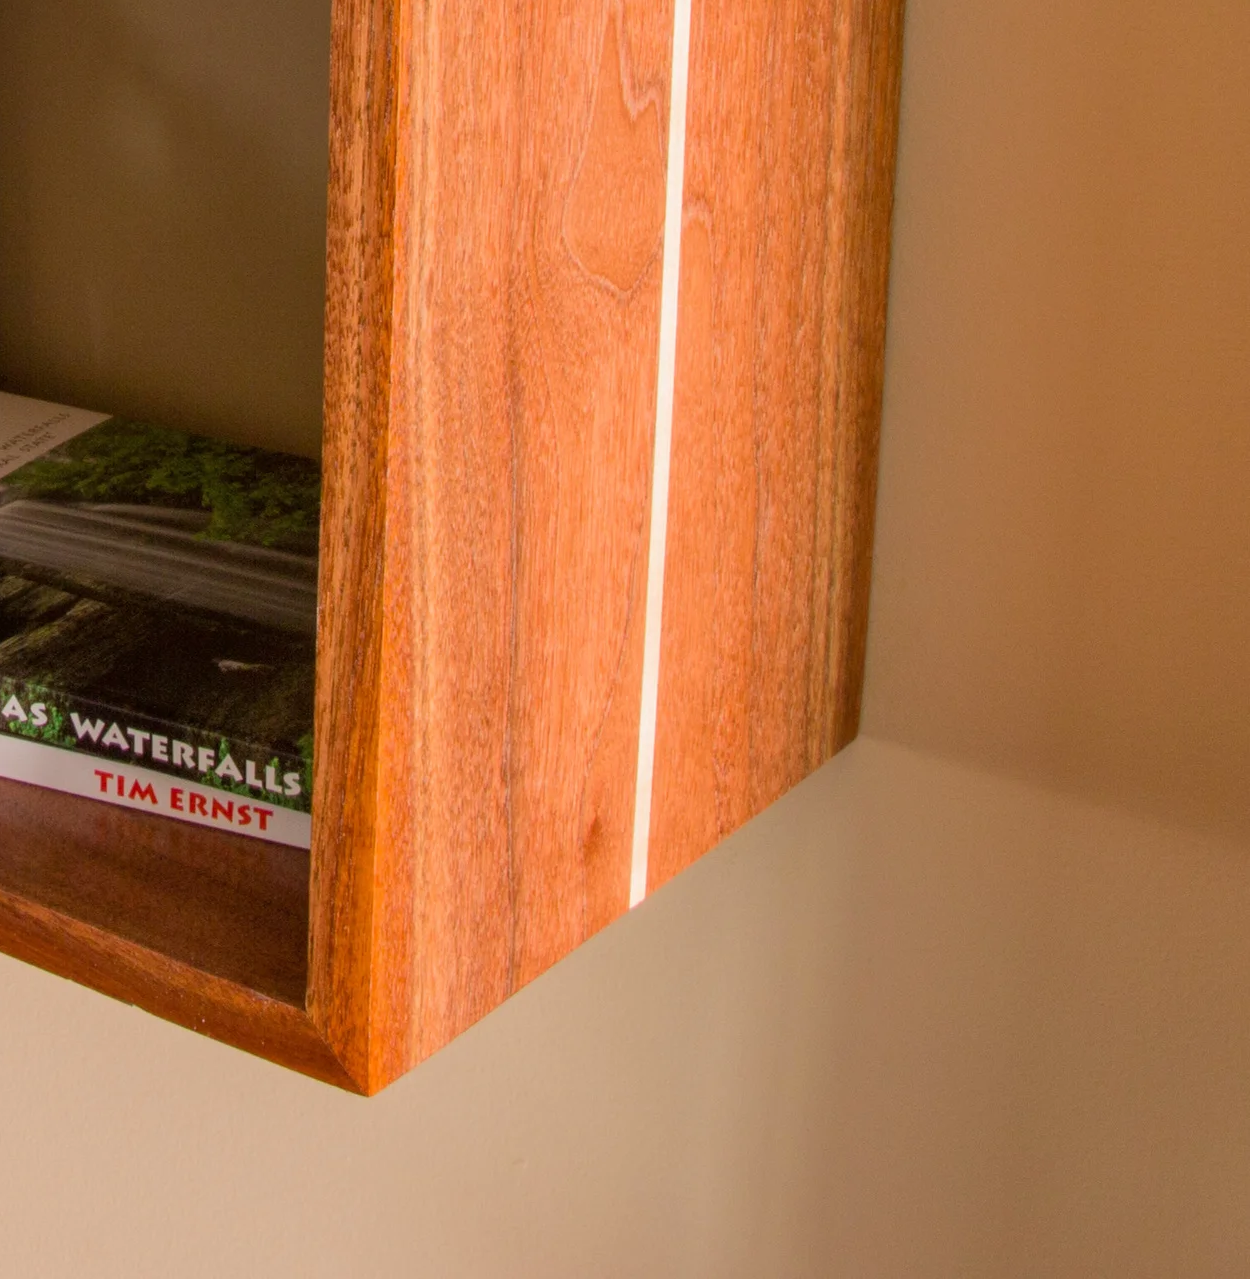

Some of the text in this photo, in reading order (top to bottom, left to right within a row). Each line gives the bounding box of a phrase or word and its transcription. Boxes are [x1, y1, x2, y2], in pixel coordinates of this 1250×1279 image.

[69, 711, 303, 797] WATERFALLS
[94, 769, 159, 805] TIM
[169, 787, 274, 832] ERNST
